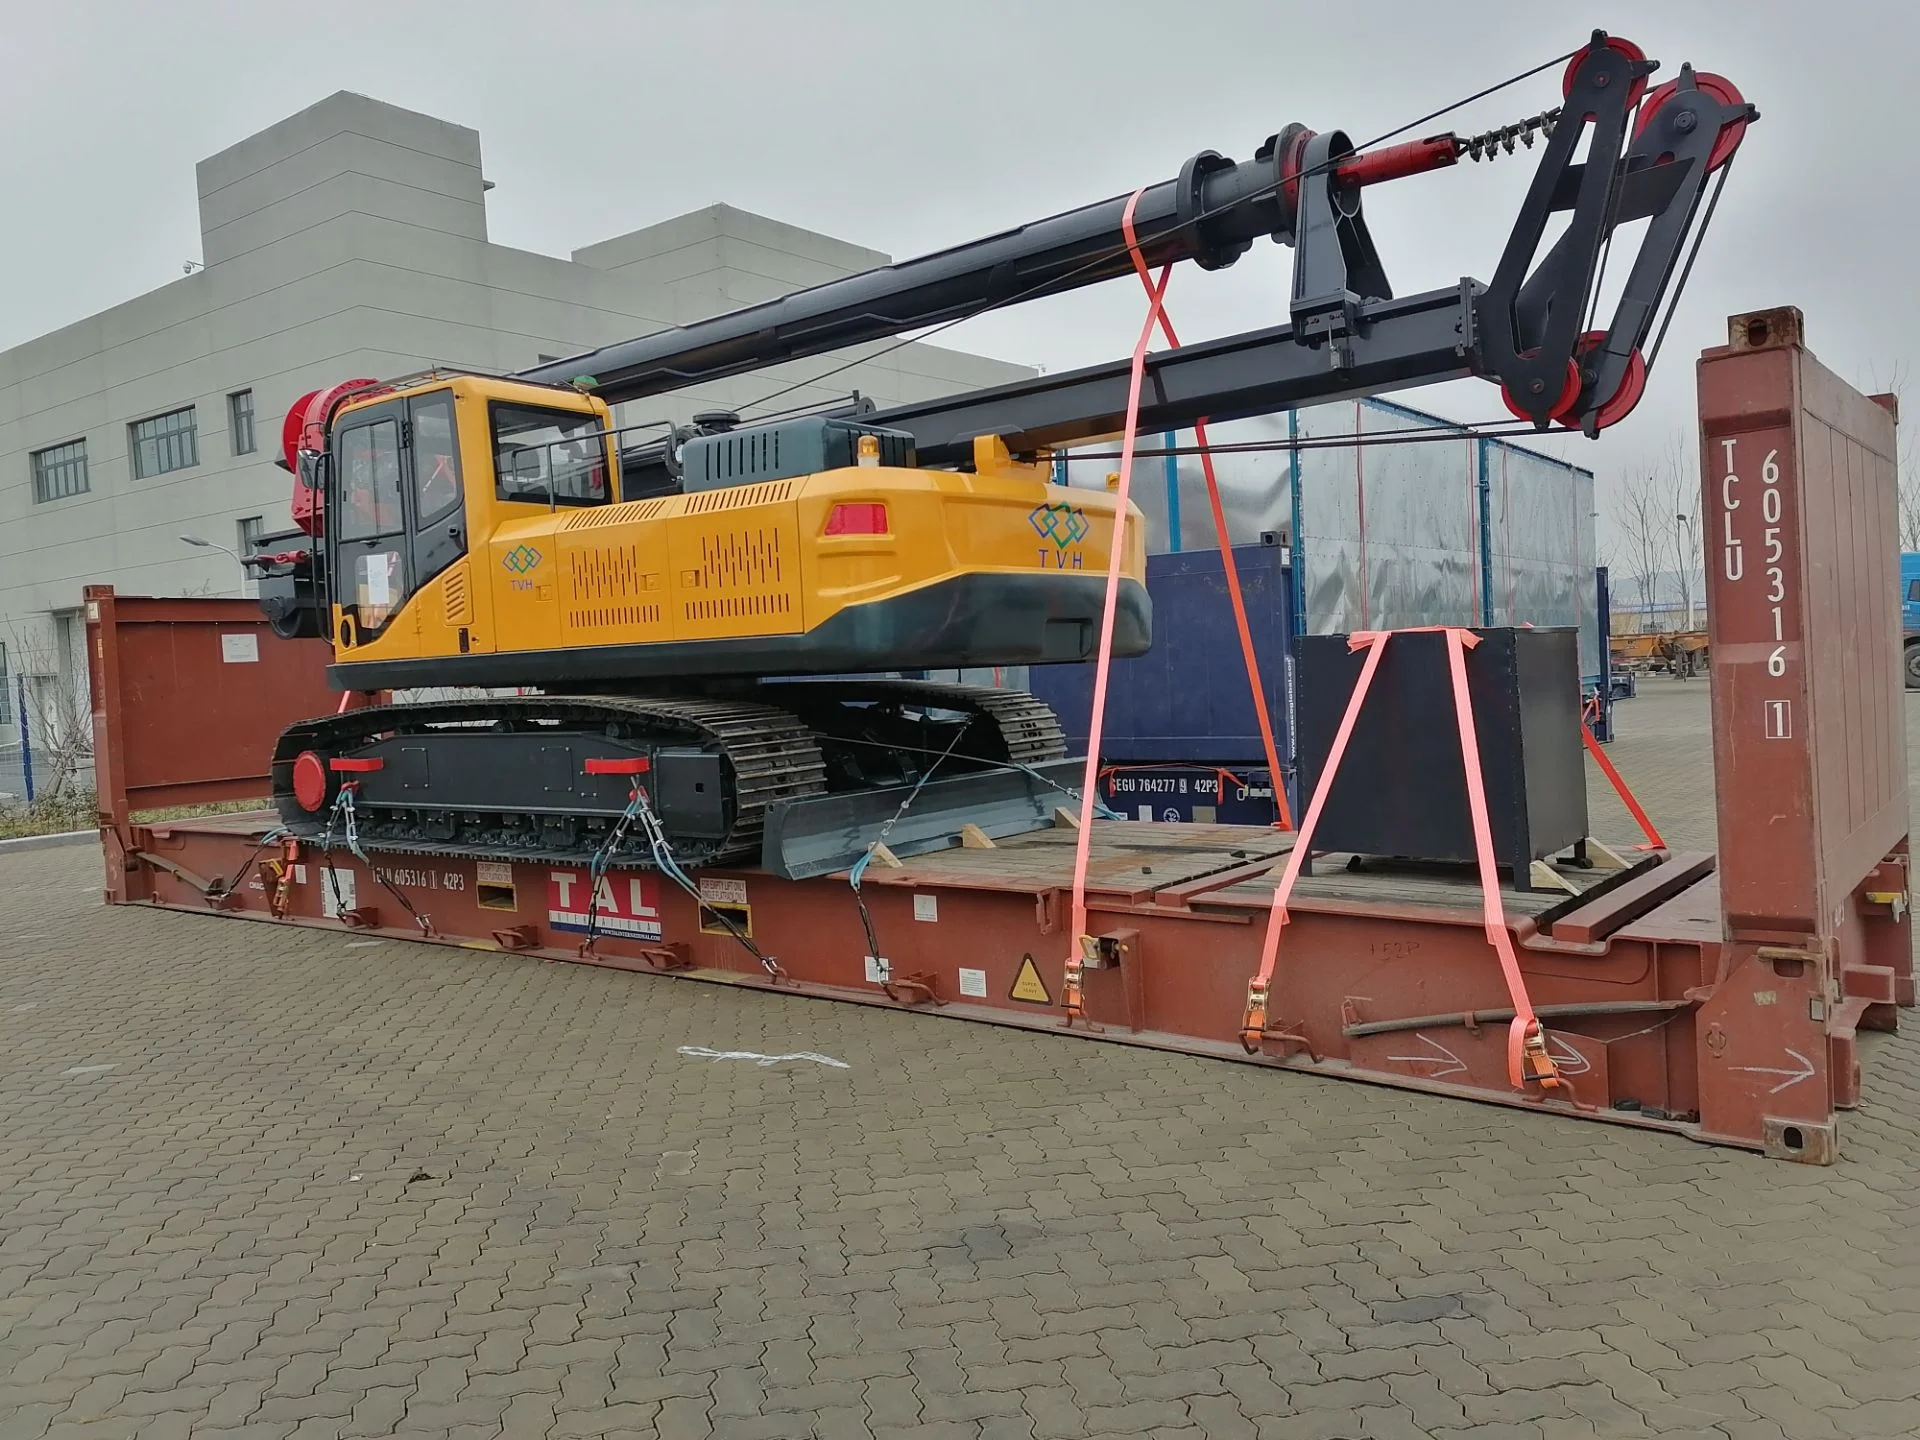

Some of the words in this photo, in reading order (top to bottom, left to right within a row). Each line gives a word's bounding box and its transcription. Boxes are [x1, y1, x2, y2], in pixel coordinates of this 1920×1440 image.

[1721, 438, 1743, 581] TCLU
[1038, 549, 1082, 570] TVH
[1761, 448, 1786, 677] 605316
[511, 580, 533, 591] TVH
[1112, 778, 1135, 792] SEGU
[1138, 778, 1175, 793] 764277
[1180, 778, 1188, 793] 9
[1194, 779, 1219, 793] 42P3
[394, 868, 427, 888] 605316
[443, 872, 465, 891] 42P3
[551, 872, 656, 917] TAL
[550, 911, 661, 934] INTERATIONAL
